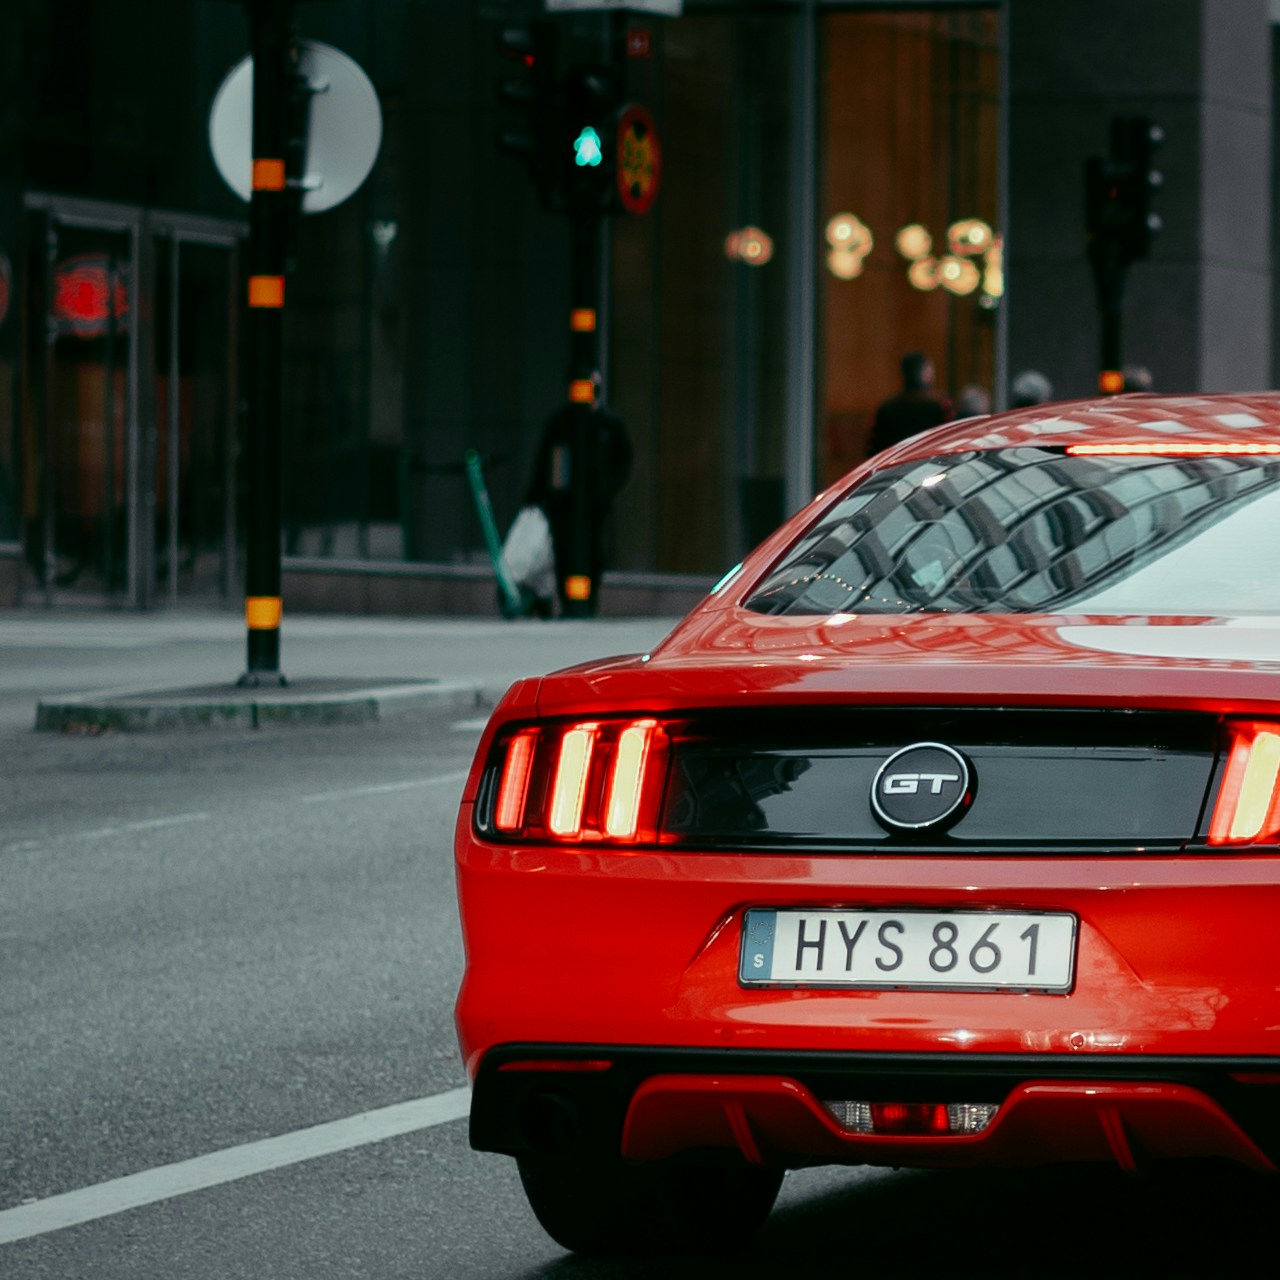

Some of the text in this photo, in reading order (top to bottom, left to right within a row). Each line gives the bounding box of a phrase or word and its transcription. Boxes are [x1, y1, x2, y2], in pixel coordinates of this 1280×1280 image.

[883, 772, 960, 795] GT
[795, 919, 1040, 976] HYS 861
[753, 952, 765, 969] S
